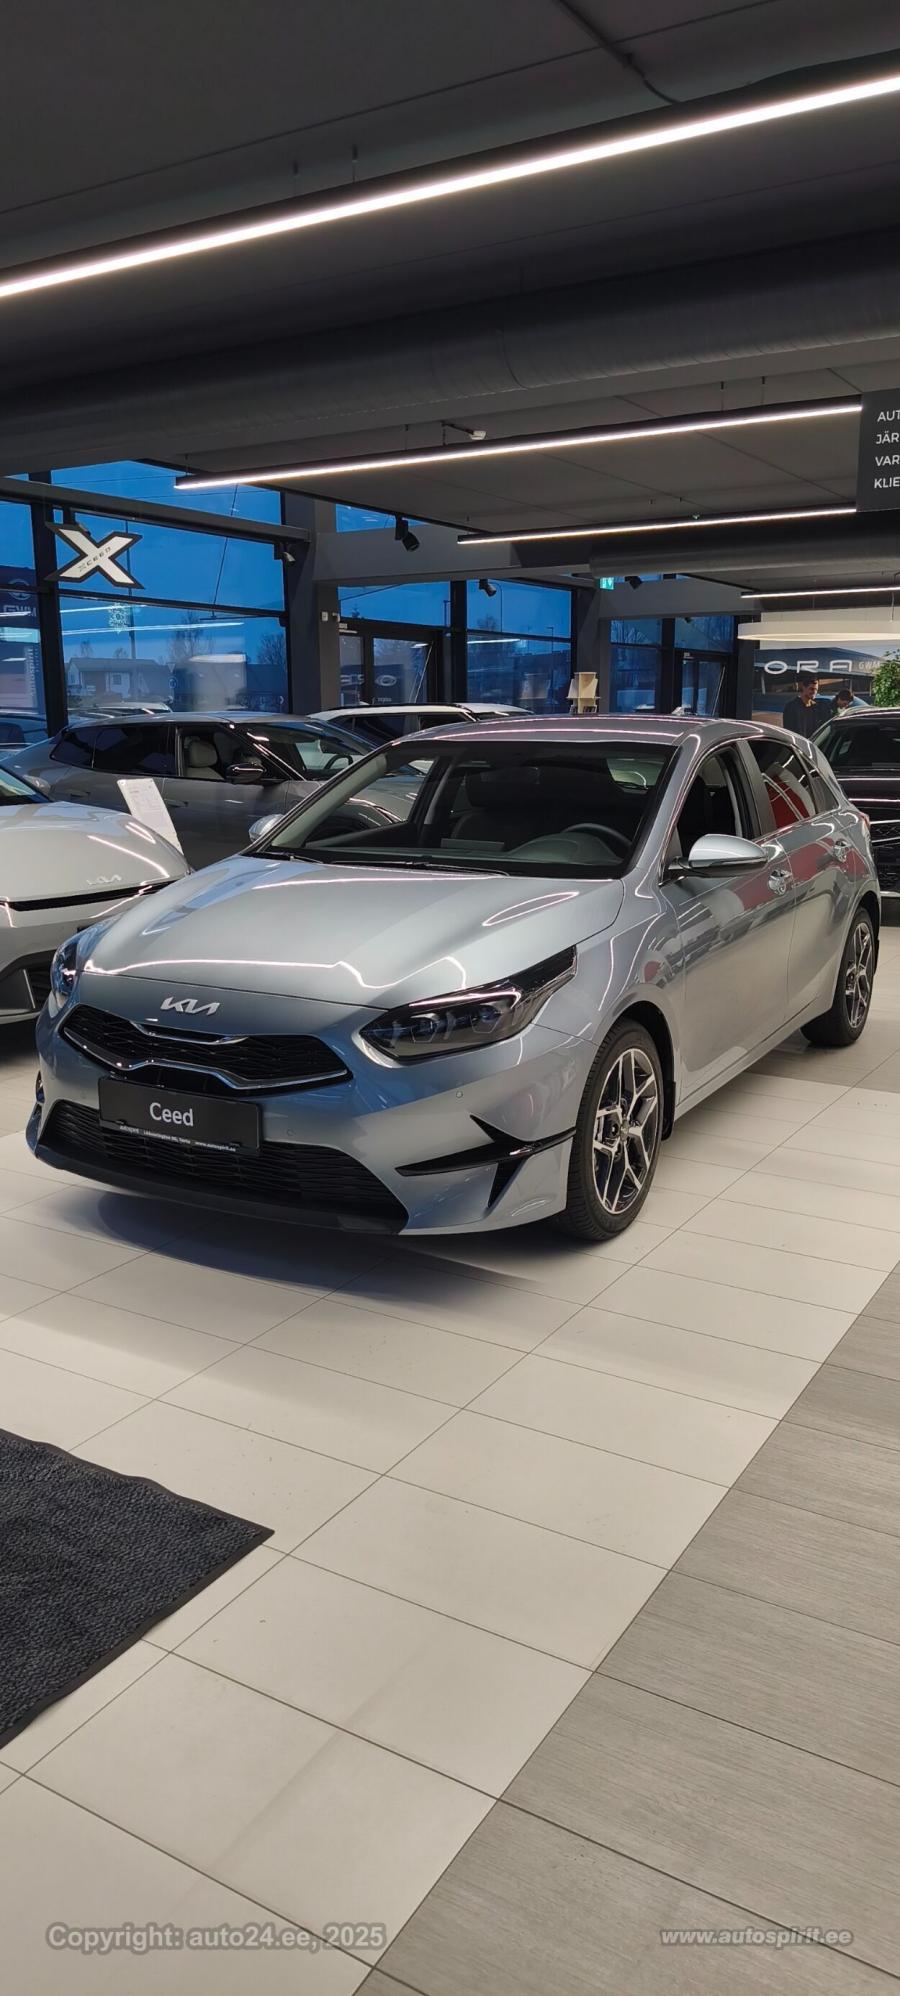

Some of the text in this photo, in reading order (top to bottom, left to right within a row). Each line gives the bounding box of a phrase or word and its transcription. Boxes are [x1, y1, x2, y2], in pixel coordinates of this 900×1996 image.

[876, 431, 900, 444] JÄR
[875, 455, 900, 467] VAR
[874, 477, 900, 489] KLIE
[764, 659, 853, 675] ORA
[160, 996, 221, 1016] KIA
[150, 1102, 194, 1127] Ceed
